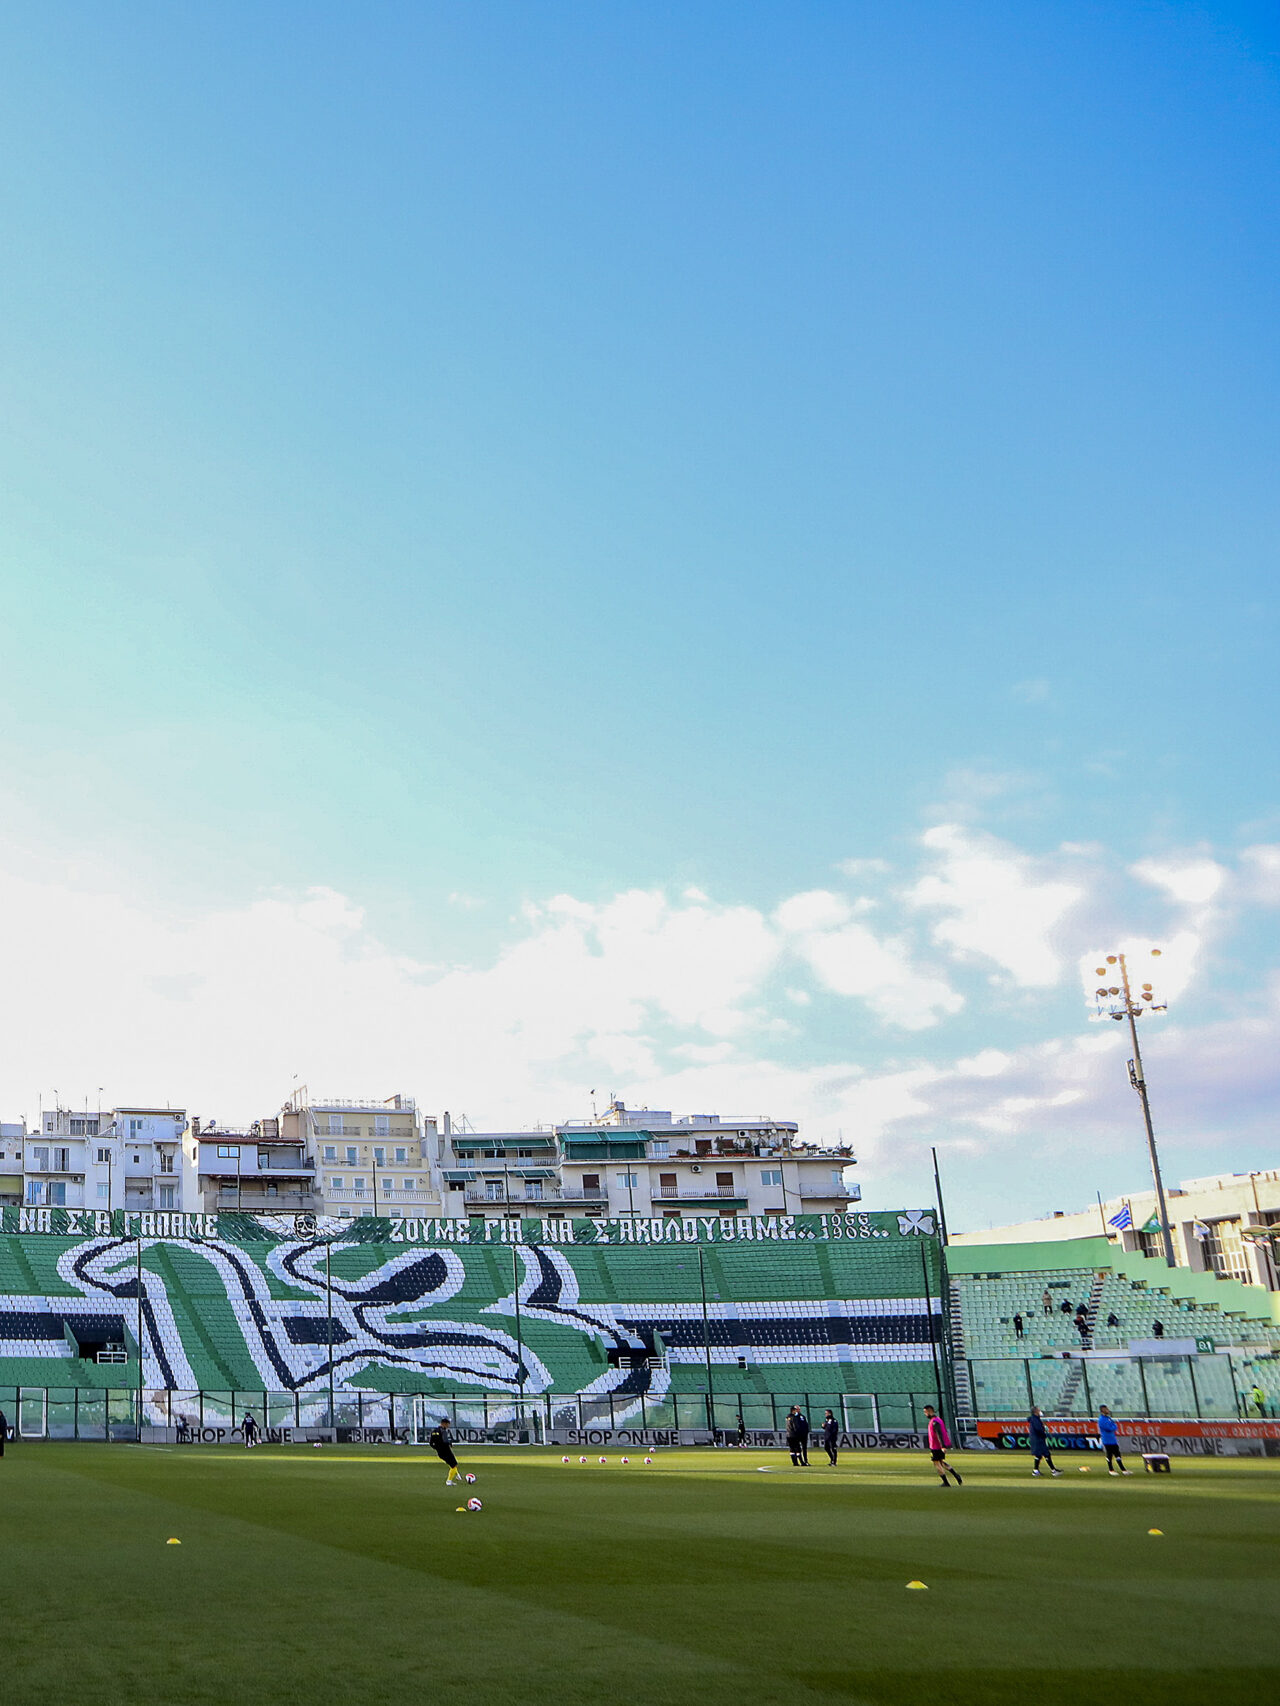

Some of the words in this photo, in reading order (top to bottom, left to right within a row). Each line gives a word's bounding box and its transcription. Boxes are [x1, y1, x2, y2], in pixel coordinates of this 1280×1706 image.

[19, 1208, 52, 1234] ΝΑ
[390, 1218, 470, 1243] ΖΟΥΜΕ
[484, 1219, 523, 1243] ΓΙΑ
[540, 1219, 575, 1243] ΝΑ
[820, 1213, 870, 1227] 1966
[182, 1428, 226, 1443] HOP
[569, 1430, 613, 1445] SHOP
[617, 1430, 679, 1446] ONLINE
[1131, 1437, 1168, 1453] SHOP
[1171, 1437, 1224, 1455] ONLINE
